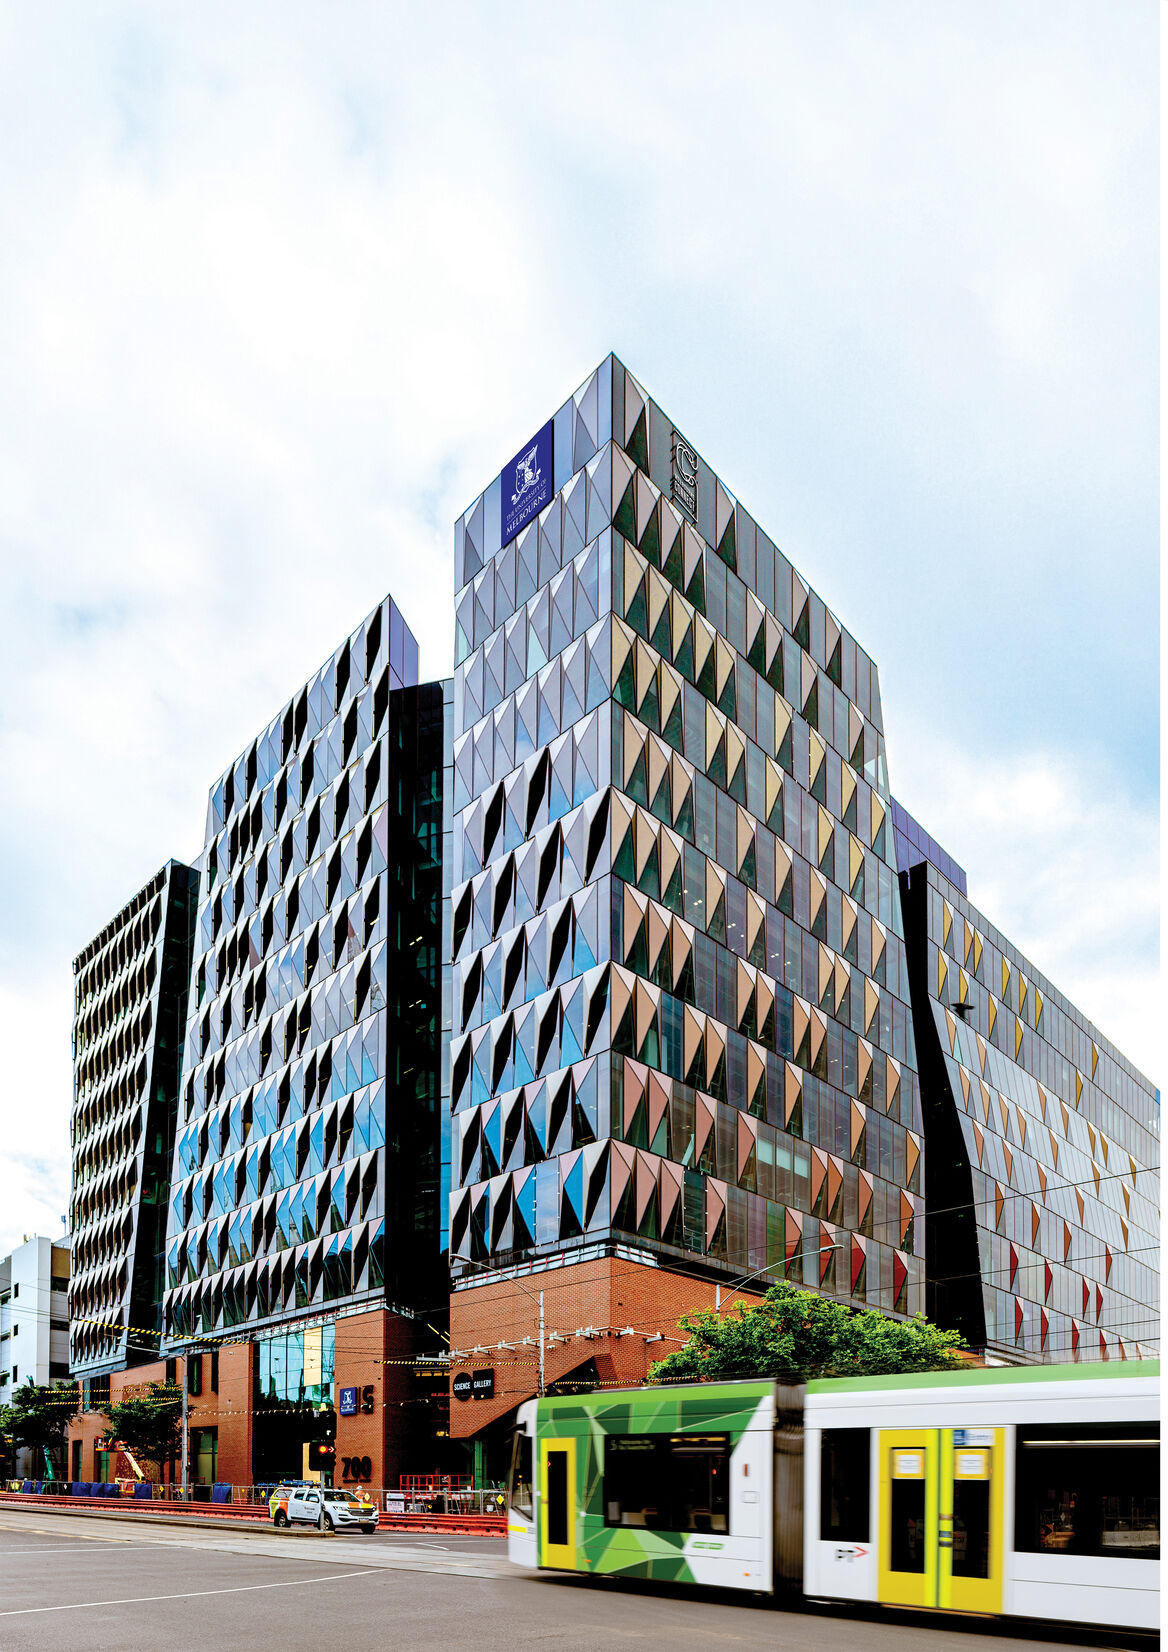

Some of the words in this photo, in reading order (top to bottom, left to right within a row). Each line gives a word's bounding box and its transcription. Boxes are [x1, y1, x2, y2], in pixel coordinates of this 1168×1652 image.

[506, 489, 547, 536] MELBOURNE
[453, 1382, 471, 1391] SCIENCE
[473, 1379, 492, 1389] GALLERY
[341, 1456, 372, 1479] 700
